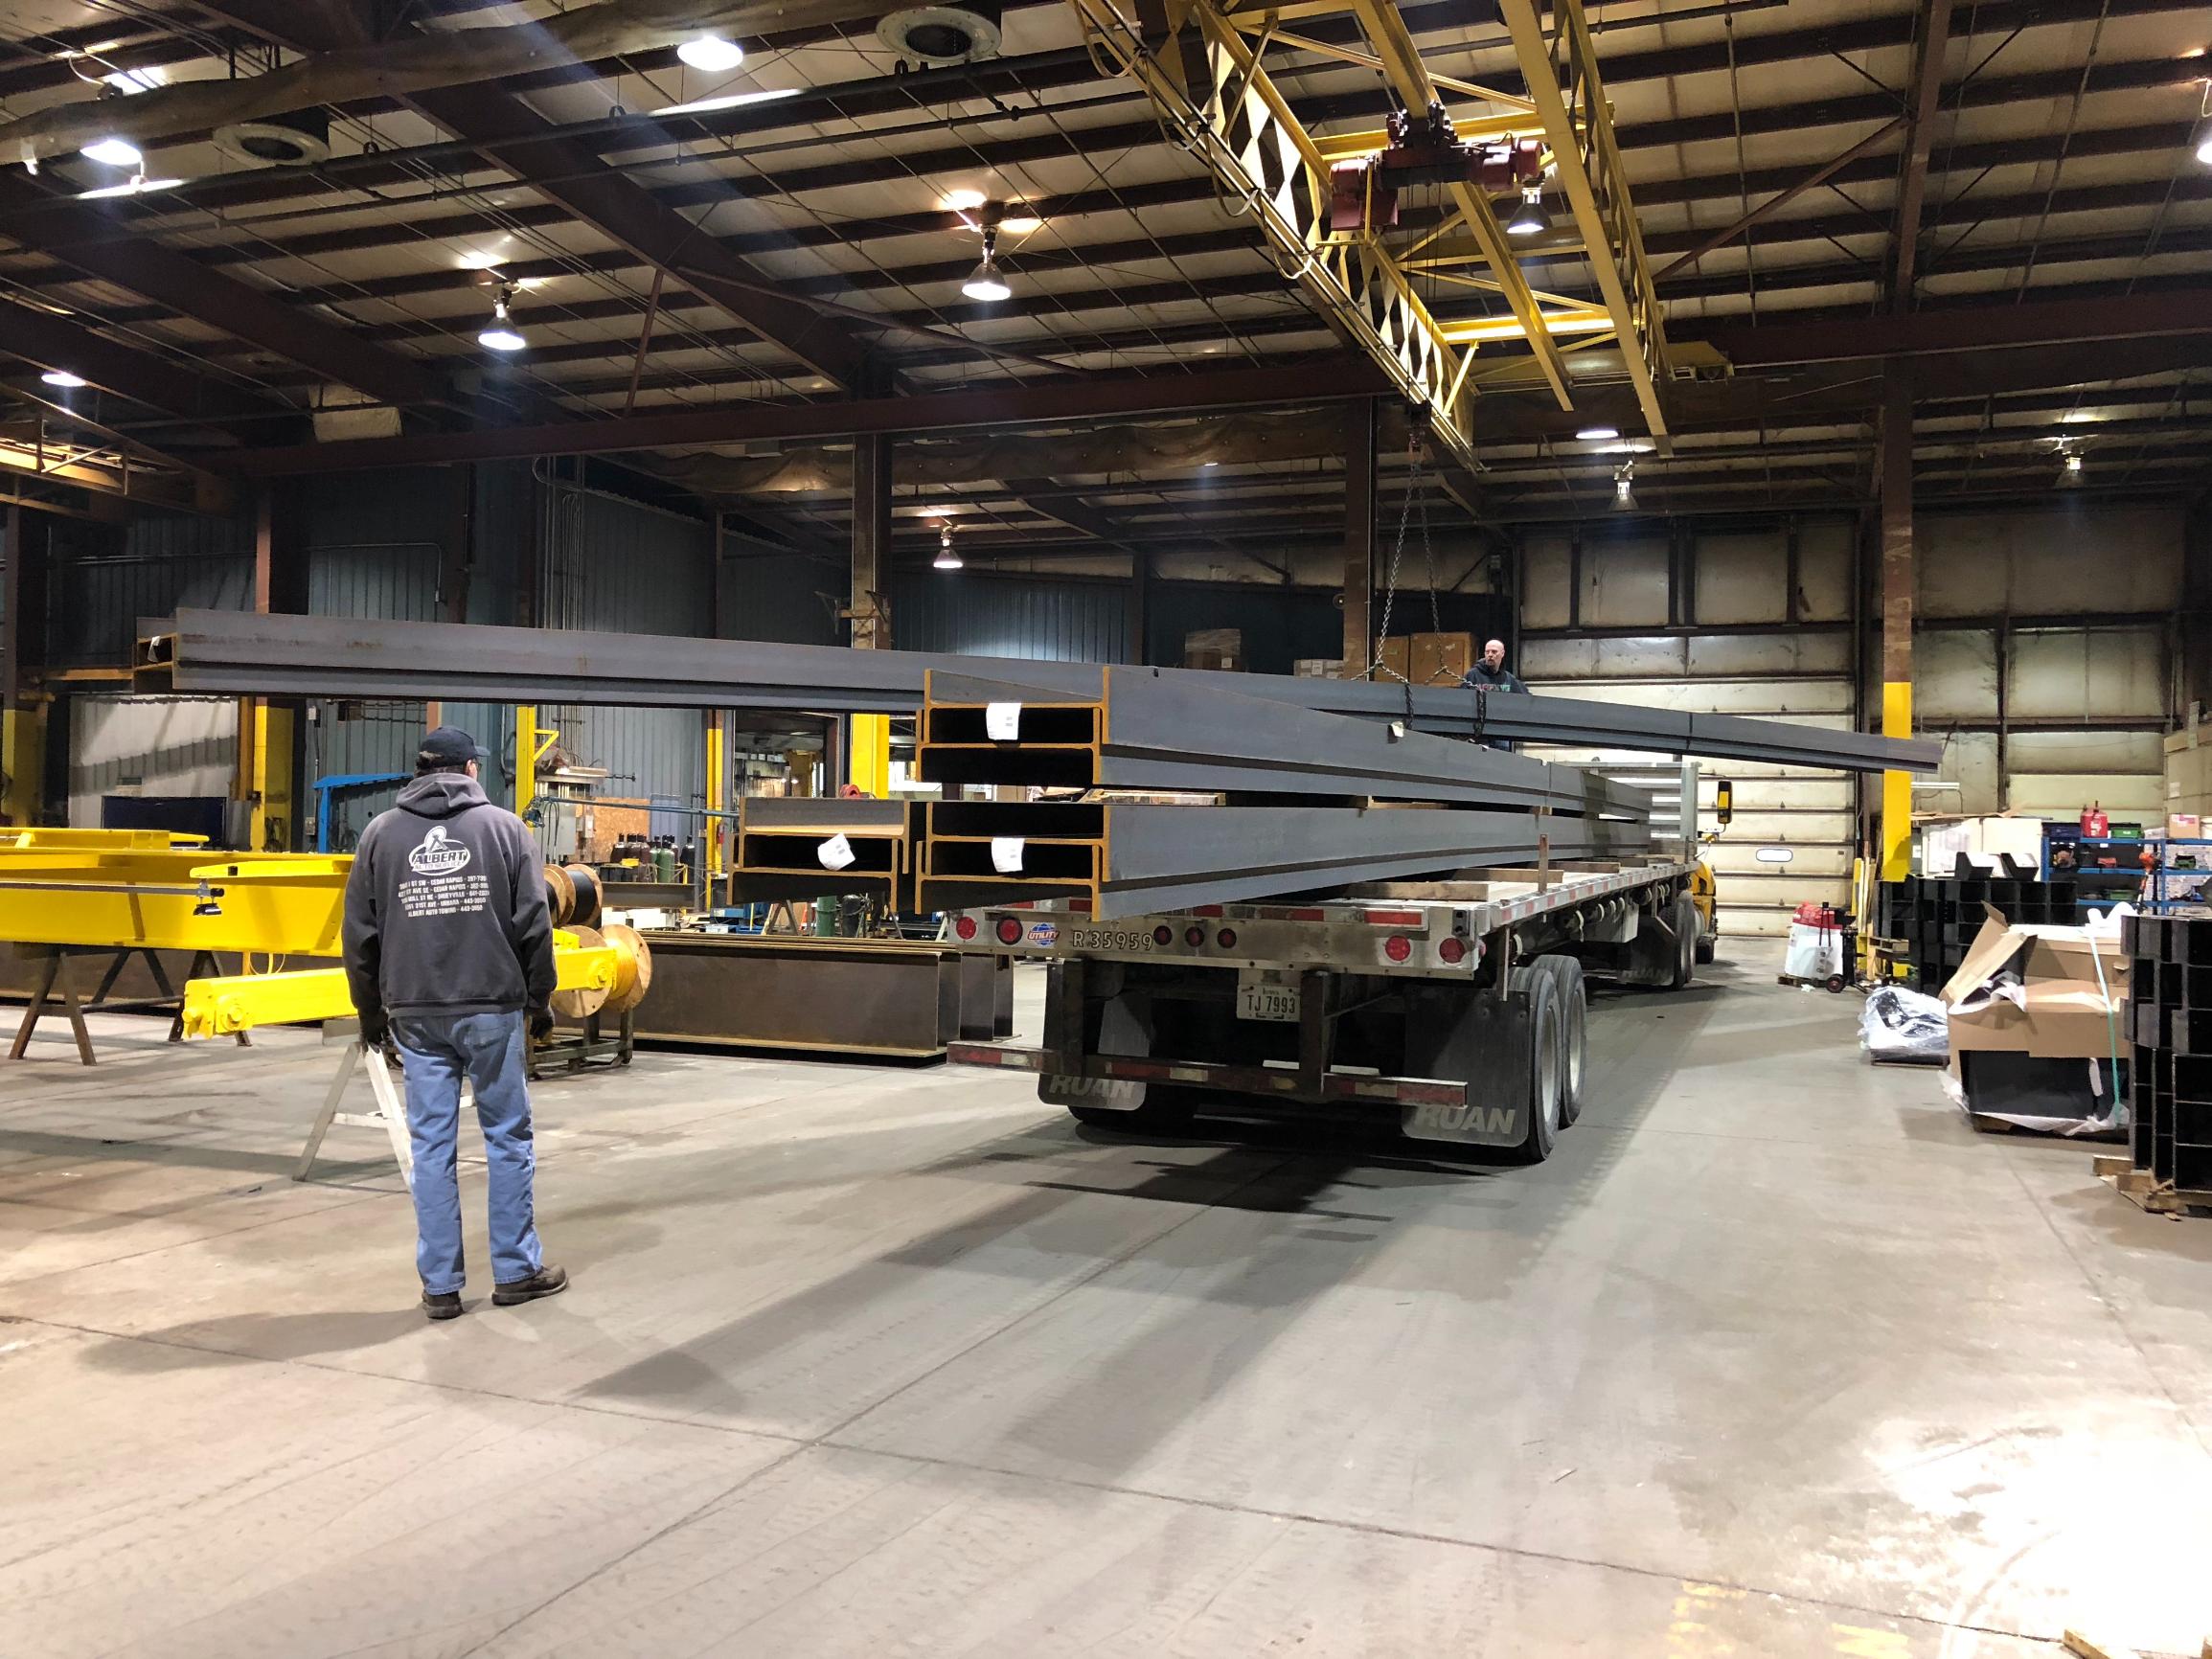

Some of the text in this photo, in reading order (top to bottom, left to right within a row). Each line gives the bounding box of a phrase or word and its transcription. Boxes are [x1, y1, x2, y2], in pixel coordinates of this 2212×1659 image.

[415, 852, 466, 865] ALBERT
[1027, 930, 1060, 941] UTILITY
[1266, 996, 1295, 1013] 7993
[1048, 1074, 1136, 1098] RUAN
[1413, 1104, 1516, 1134] RUAN
